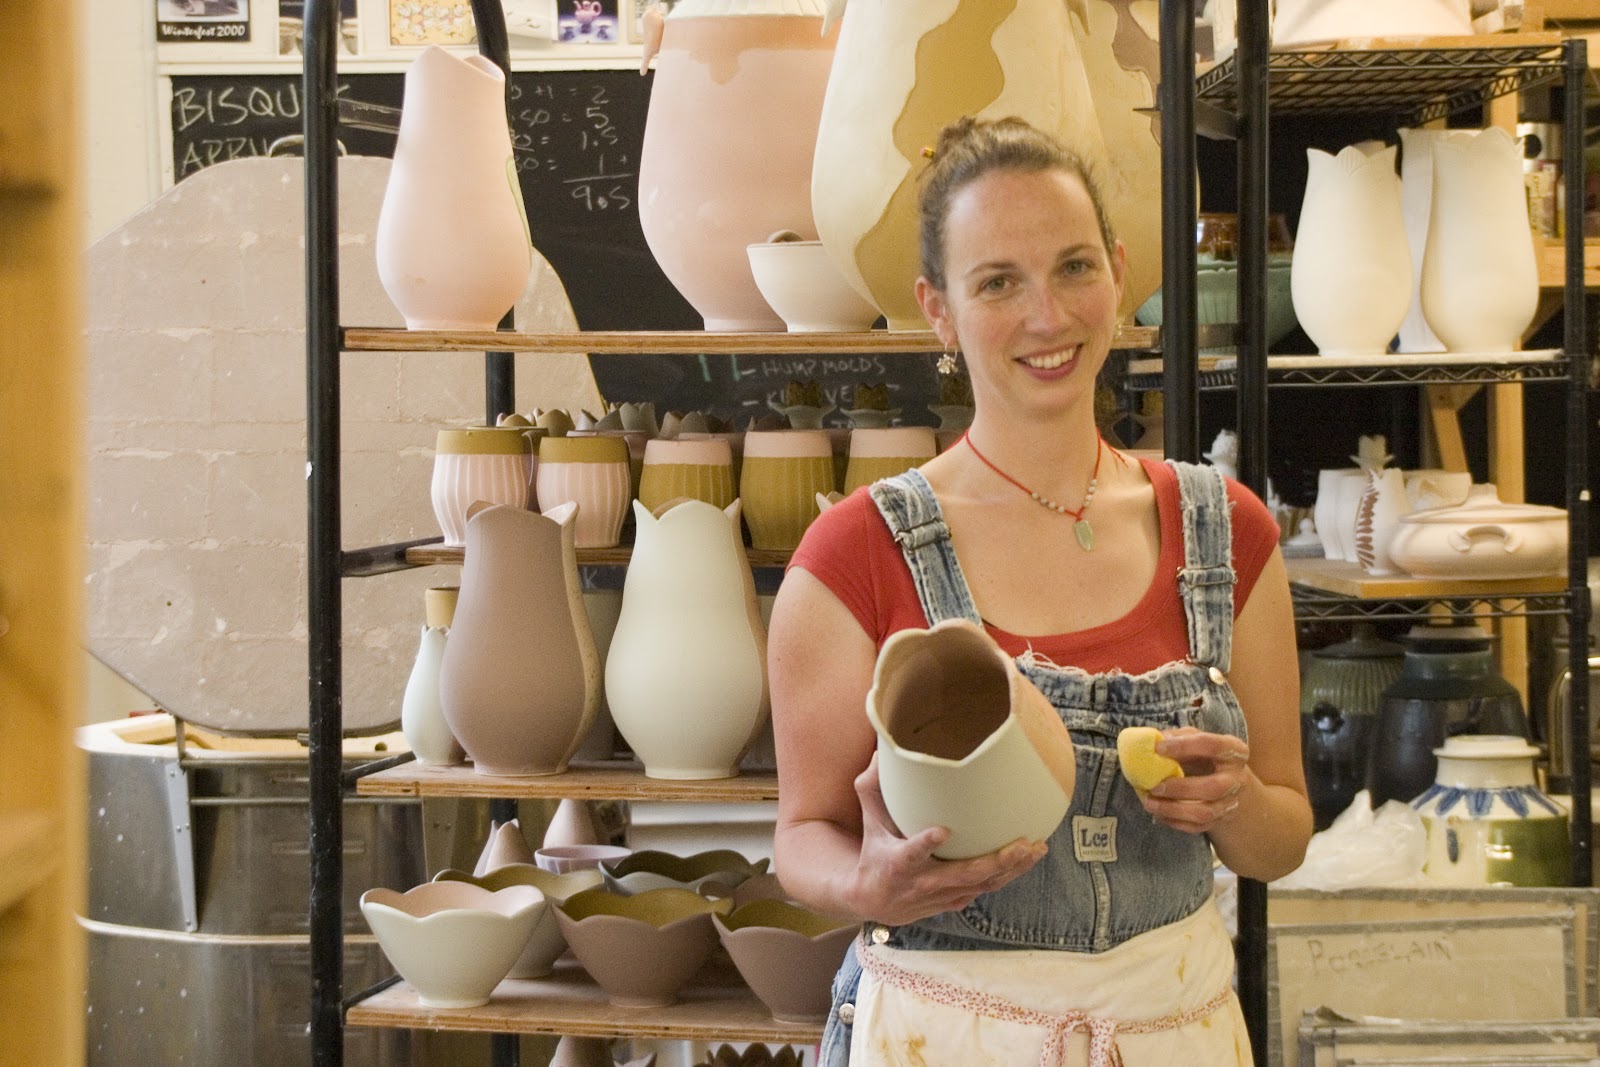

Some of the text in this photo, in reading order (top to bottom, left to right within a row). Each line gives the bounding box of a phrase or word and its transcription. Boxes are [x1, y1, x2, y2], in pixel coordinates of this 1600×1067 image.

[161, 24, 246, 40] Winterfest 2000
[592, 85, 609, 104] 2
[586, 106, 610, 129] 5
[571, 184, 632, 211] 9.5
[1081, 828, 1108, 848] Lee
